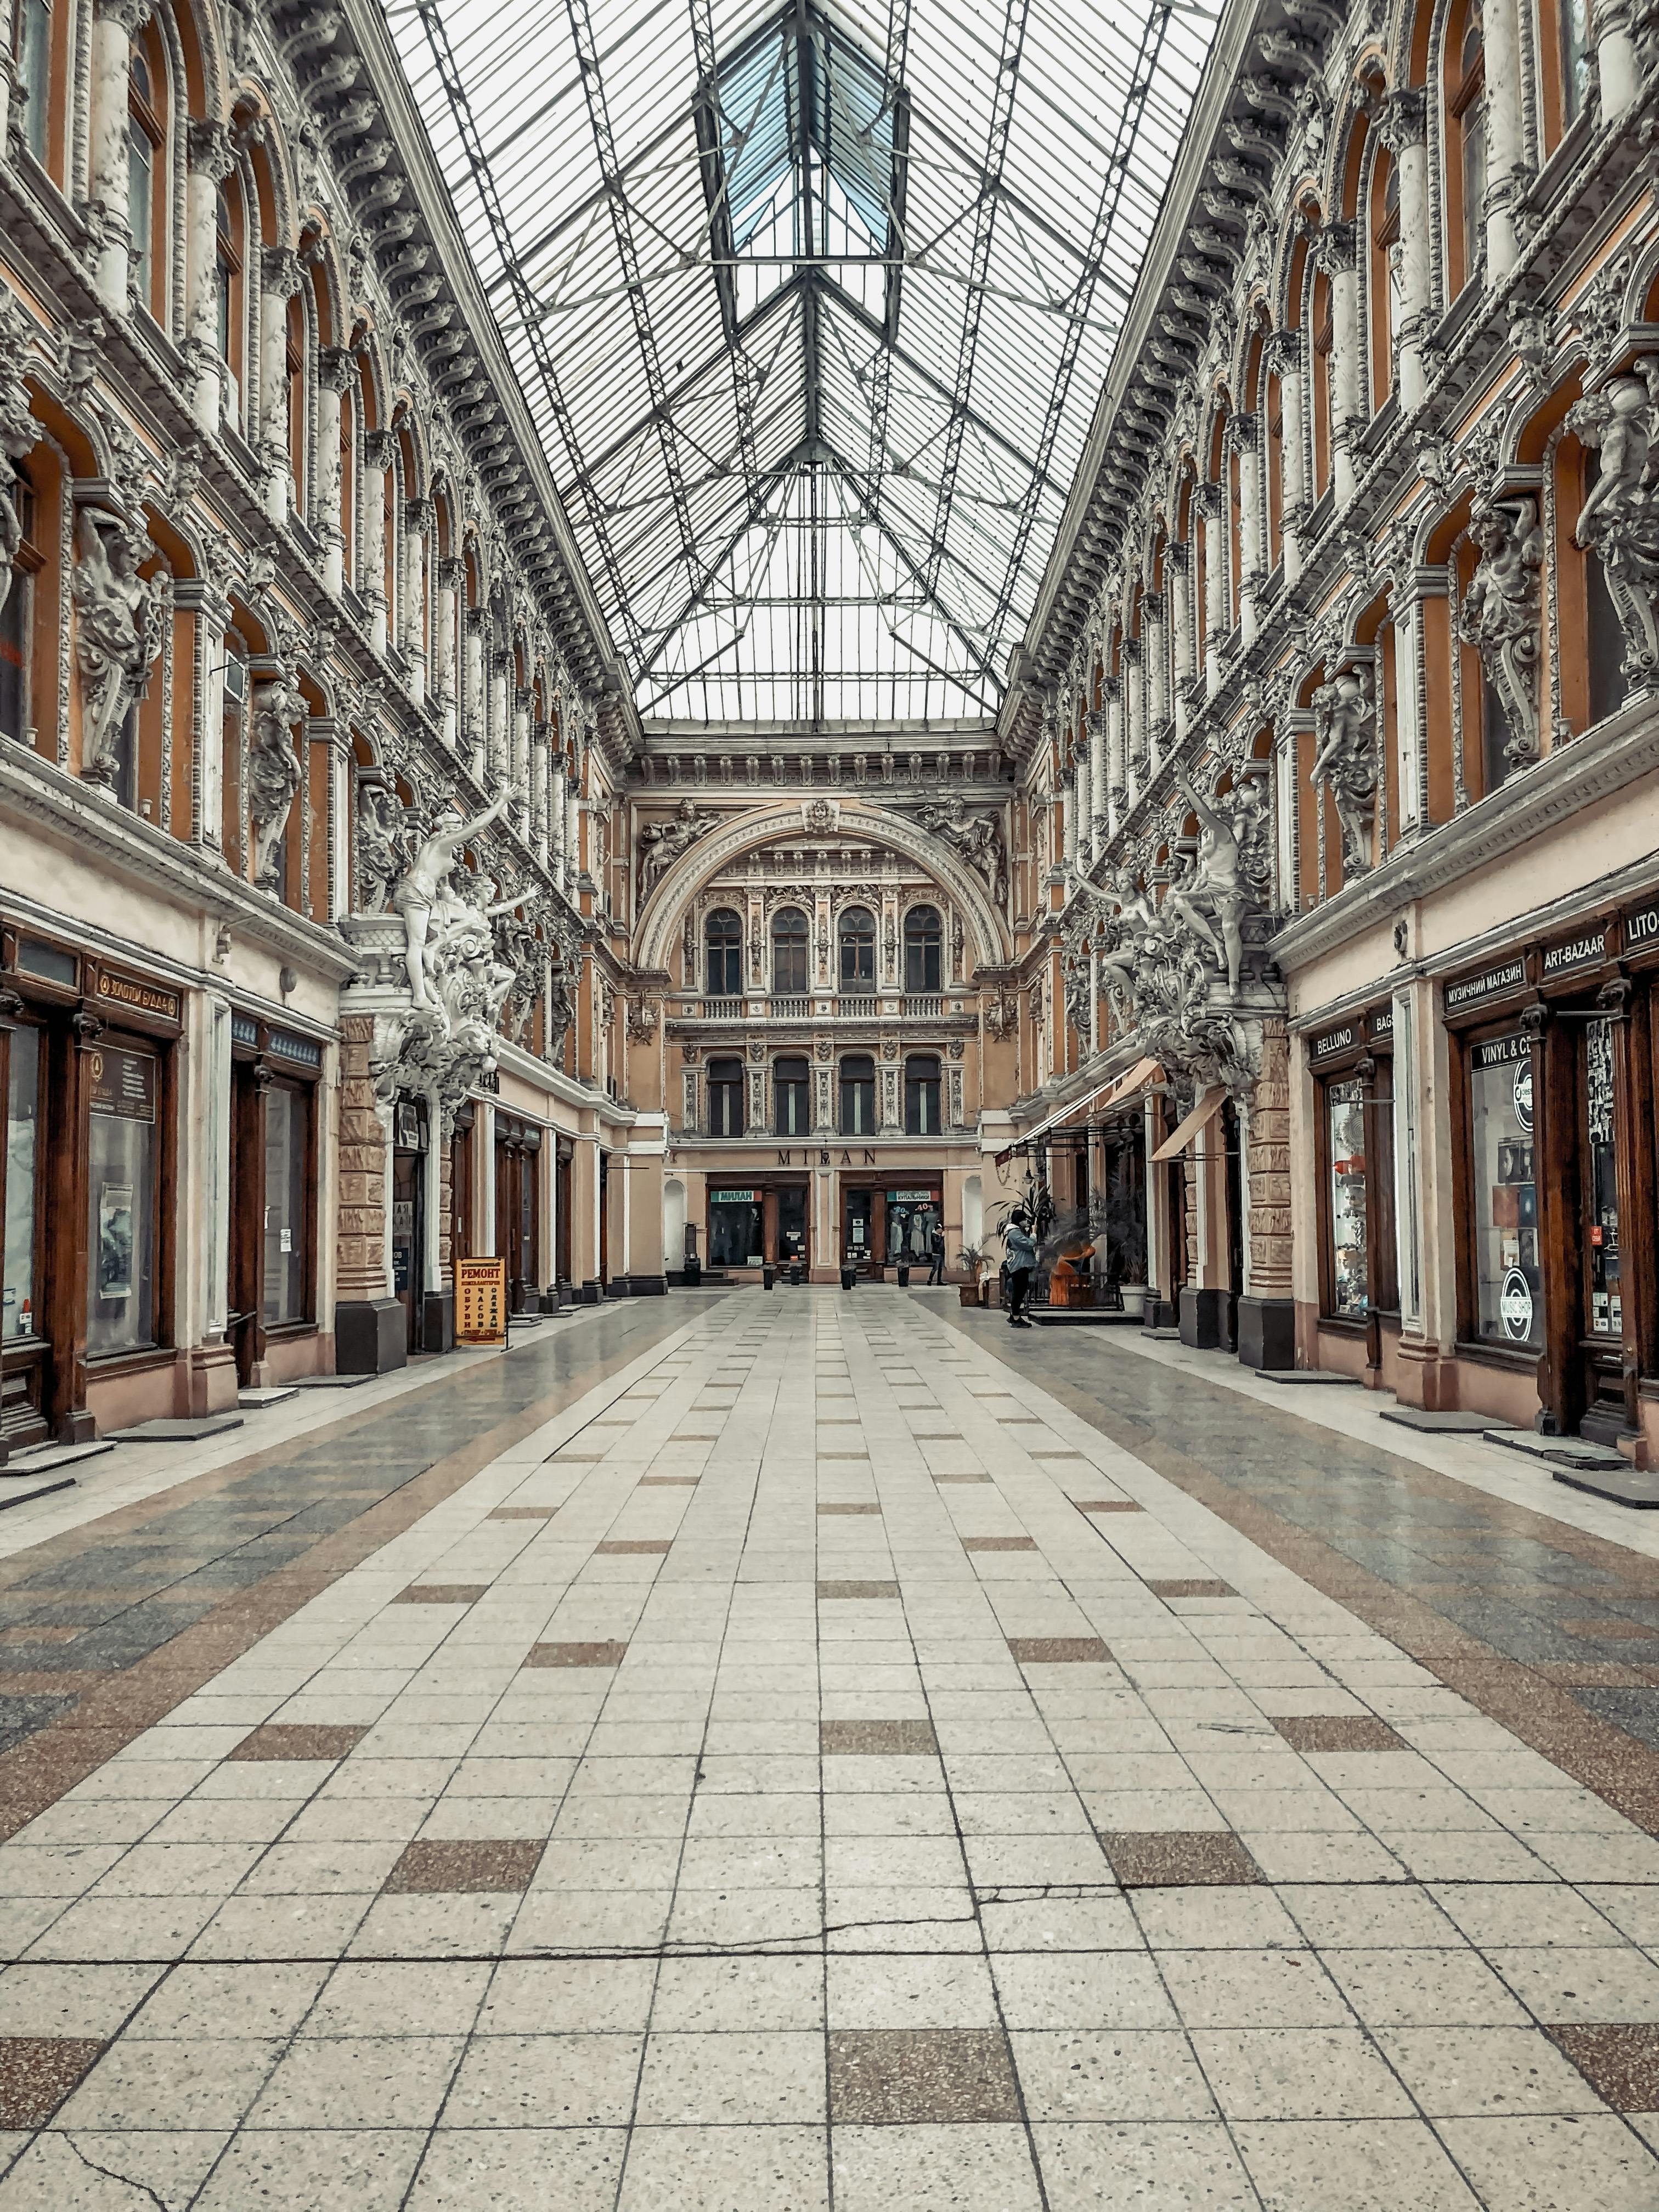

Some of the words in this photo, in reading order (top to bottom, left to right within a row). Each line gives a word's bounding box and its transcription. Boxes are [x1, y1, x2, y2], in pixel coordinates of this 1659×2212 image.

[1628, 911, 1659, 940] LITO
[1545, 934, 1605, 969] ART-BAZAAR
[1448, 976, 1486, 1003] МУЗИЧНИЙ
[1487, 964, 1522, 990] МАГАЗИН
[1376, 1014, 1393, 1031] BAG
[1317, 1028, 1351, 1055] BELLUNO
[1482, 1042, 1509, 1064] VINYL
[1510, 1040, 1517, 1057] &
[777, 1149, 876, 1165] MILAN
[720, 1191, 752, 1201] МИЛАН
[461, 1268, 501, 1279] РЕМОНТ
[1502, 1301, 1517, 1313] MUSIC
[1519, 1301, 1531, 1314] SHOP
